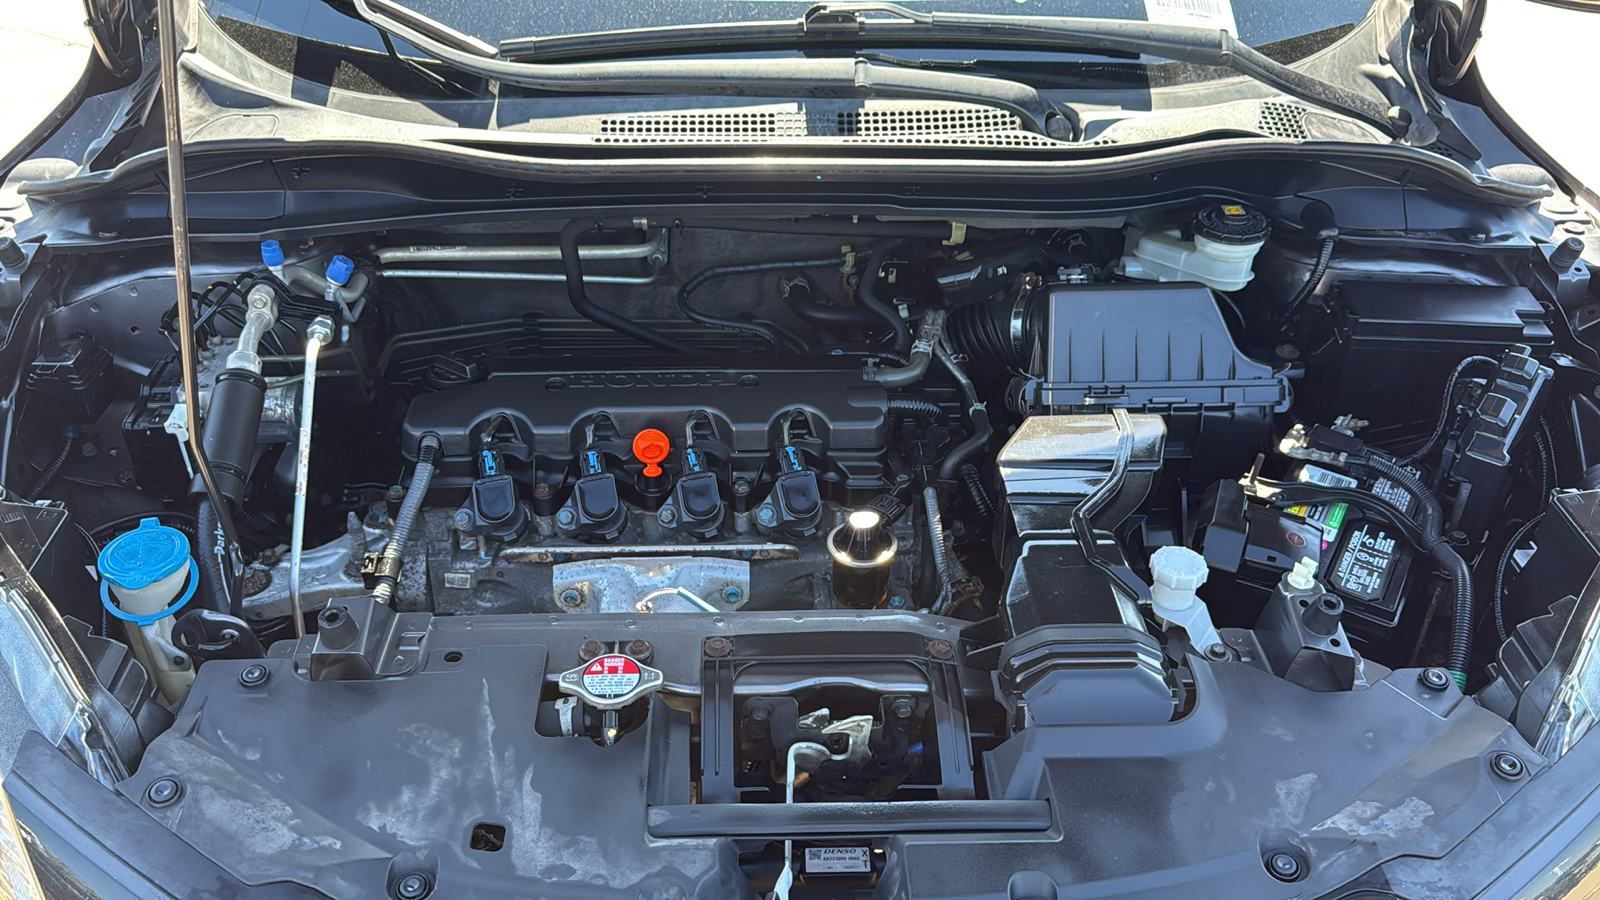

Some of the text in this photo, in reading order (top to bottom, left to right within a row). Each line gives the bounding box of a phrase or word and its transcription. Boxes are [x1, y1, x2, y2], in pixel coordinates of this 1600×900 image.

[568, 373, 736, 389] HONDA
[1338, 551, 1354, 573] DANGER
[861, 849, 869, 857] X
[862, 860, 869, 869] T
